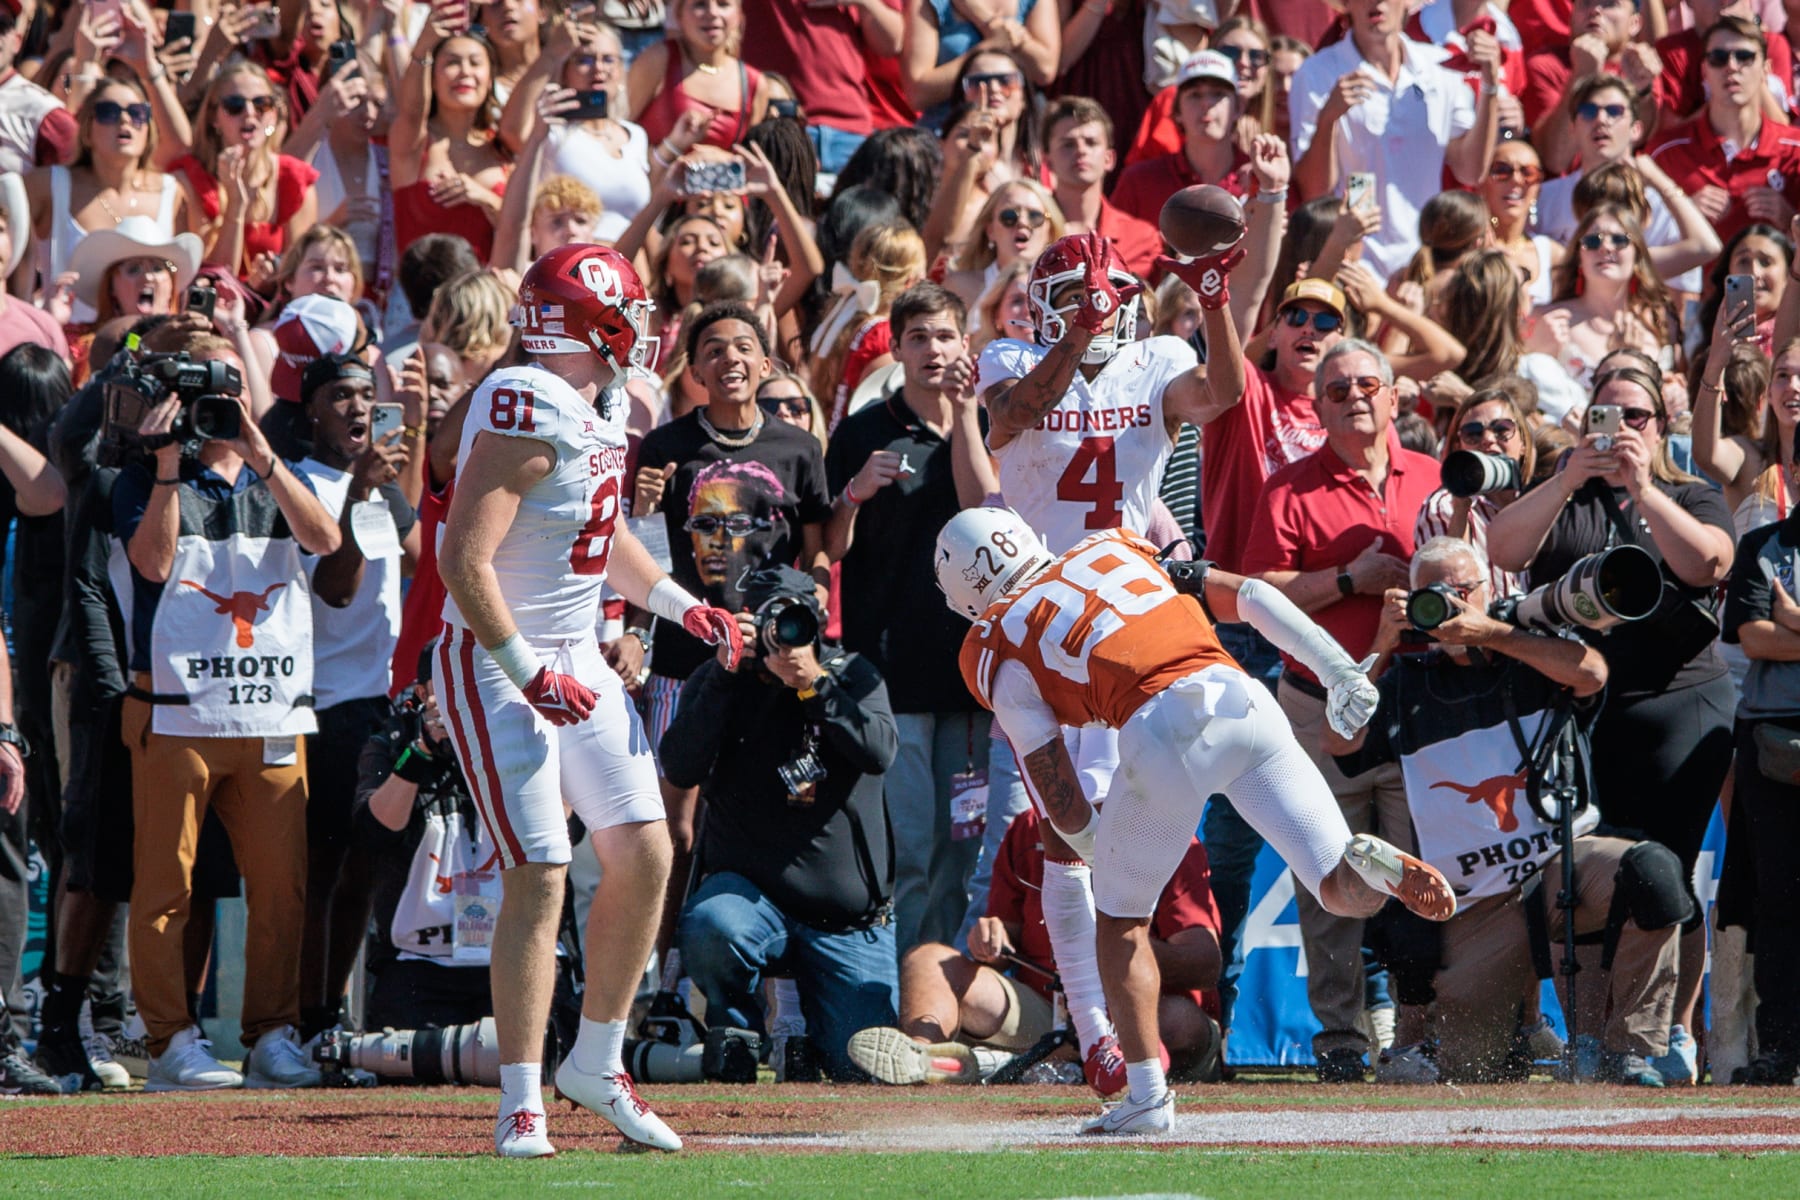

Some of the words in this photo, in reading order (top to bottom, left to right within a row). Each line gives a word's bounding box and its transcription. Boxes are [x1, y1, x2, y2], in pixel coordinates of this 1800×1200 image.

[579, 257, 624, 307] OU
[489, 387, 537, 433] 81
[1056, 435, 1124, 530] 4
[569, 474, 625, 576] 8
[975, 531, 1018, 576] 28
[1001, 540, 1178, 684] 28
[186, 655, 295, 679] PHOTO
[228, 684, 273, 705] 173
[1503, 861, 1538, 885] 79
